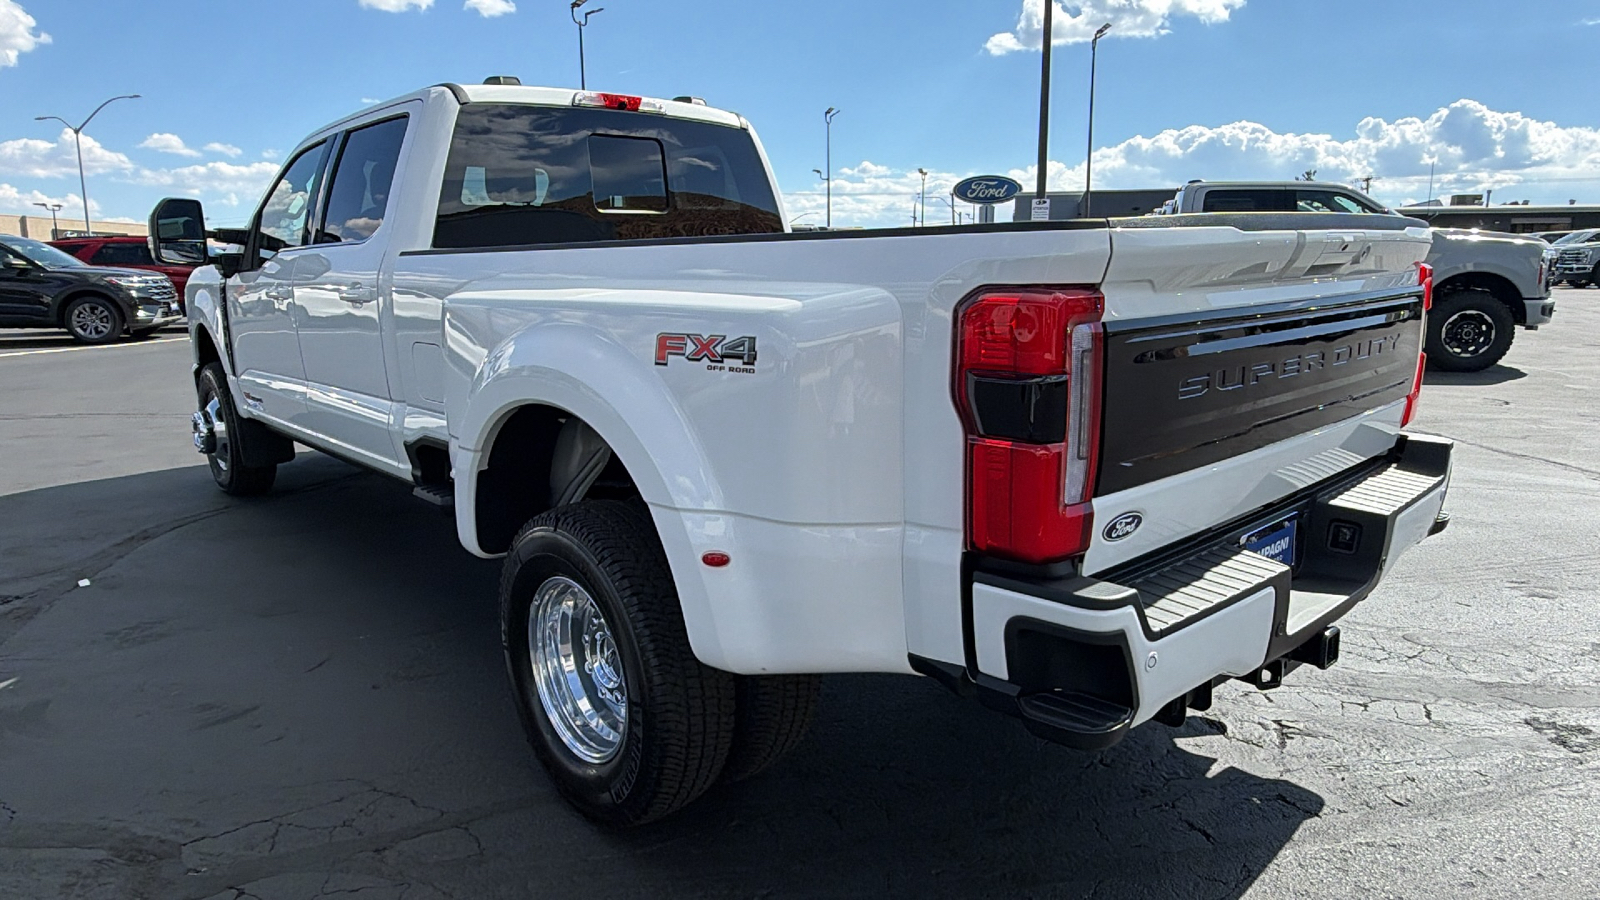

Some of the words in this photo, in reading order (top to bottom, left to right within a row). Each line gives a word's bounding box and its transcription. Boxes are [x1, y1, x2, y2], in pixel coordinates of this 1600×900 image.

[966, 181, 1008, 198] Ford
[655, 332, 757, 366] FX4
[706, 364, 726, 372] OFF
[728, 366, 755, 374] ROAD
[1178, 349, 1325, 400] SUPER
[1332, 332, 1401, 366] DUTY
[1111, 517, 1138, 538] Ford
[1257, 536, 1290, 557] MPAGNI
